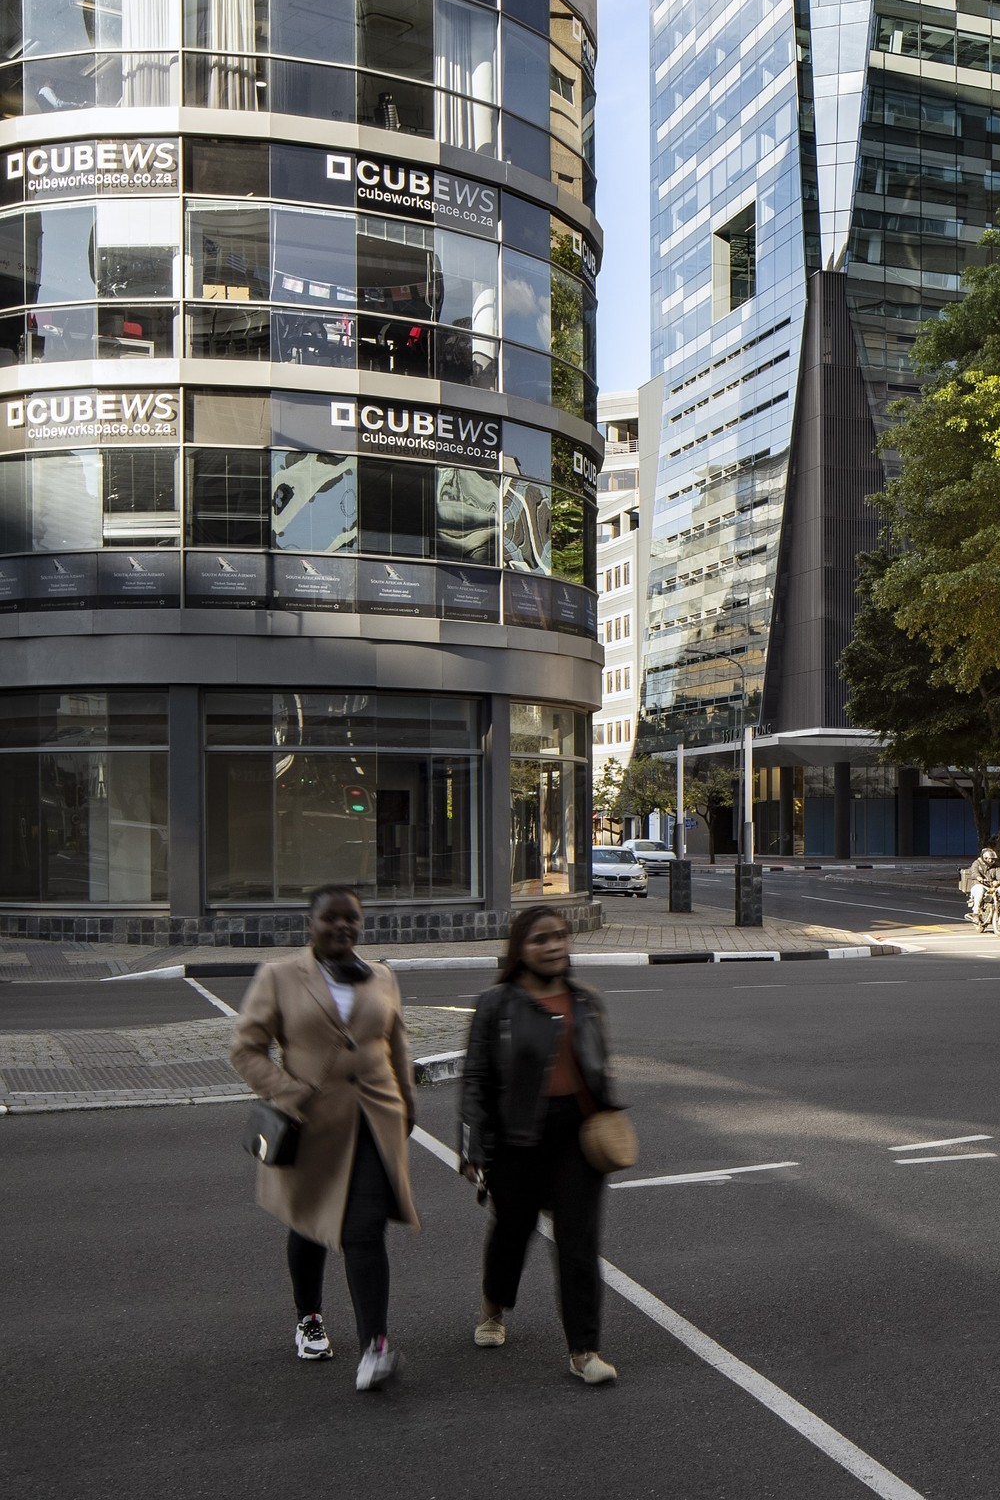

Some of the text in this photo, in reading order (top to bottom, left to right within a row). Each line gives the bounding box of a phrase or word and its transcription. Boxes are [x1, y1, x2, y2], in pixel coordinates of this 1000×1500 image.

[28, 172, 172, 191] cubeworkspace.co.za
[357, 187, 494, 228] cubeworkspace.co.za
[28, 422, 171, 439] cubeworkspace.co.za
[362, 432, 498, 460] cubeworkspace.co.za
